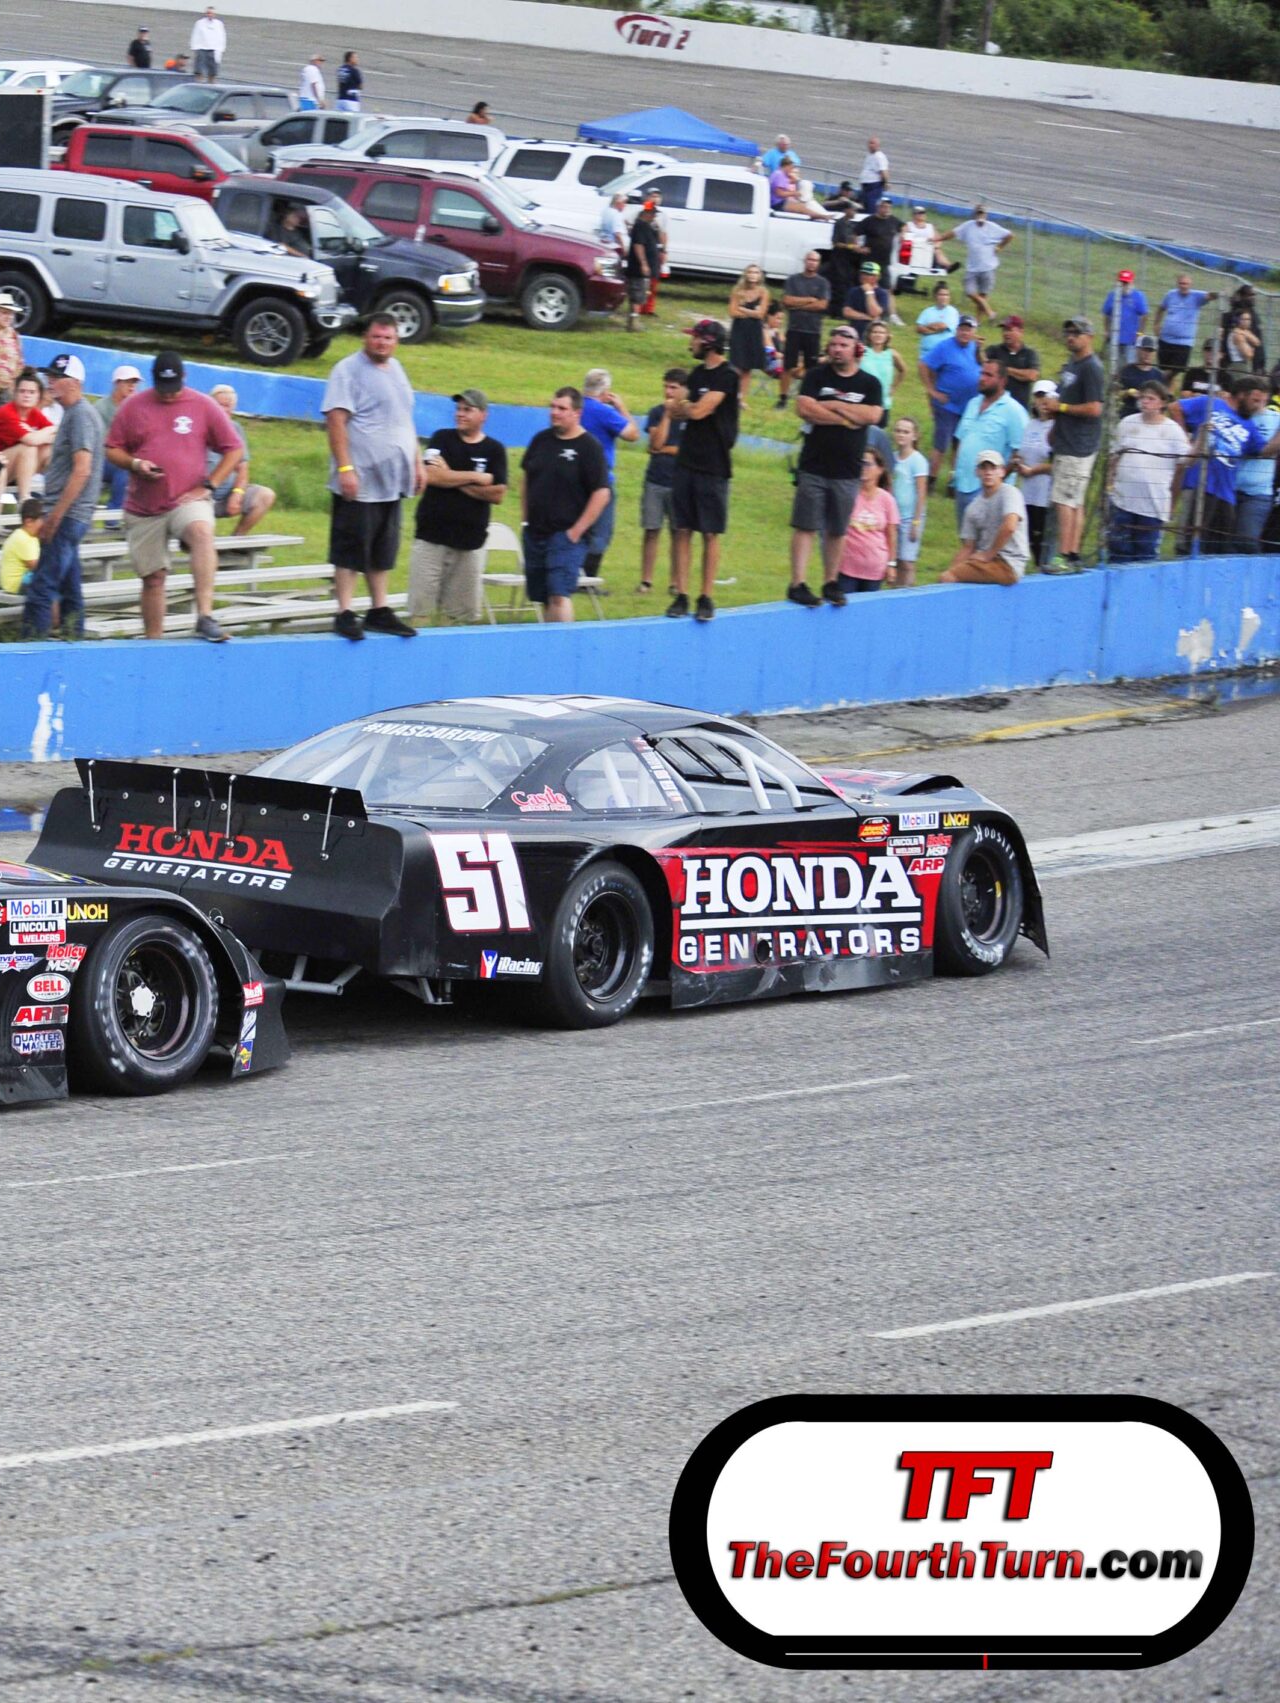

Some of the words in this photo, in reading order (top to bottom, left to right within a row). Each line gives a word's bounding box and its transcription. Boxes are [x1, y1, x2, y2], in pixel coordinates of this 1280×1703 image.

[674, 29, 691, 50] 2
[943, 813, 970, 827] UNOH
[115, 823, 294, 872] HONDA
[910, 858, 944, 872] ARP
[104, 857, 287, 891] GENERATORS
[428, 830, 532, 934] 51
[681, 855, 921, 914] HONDA
[10, 900, 47, 916] Mobil
[52, 901, 62, 914] 1
[67, 903, 108, 920] UNOH
[12, 921, 56, 933] LINCOLN
[22, 933, 61, 943] WELDERS
[47, 945, 87, 960] Holley
[45, 960, 81, 973] MSD
[497, 956, 543, 976] iRacing
[34, 980, 64, 993] BELL
[15, 1006, 68, 1023] ARP
[13, 1033, 61, 1047] QUARTER
